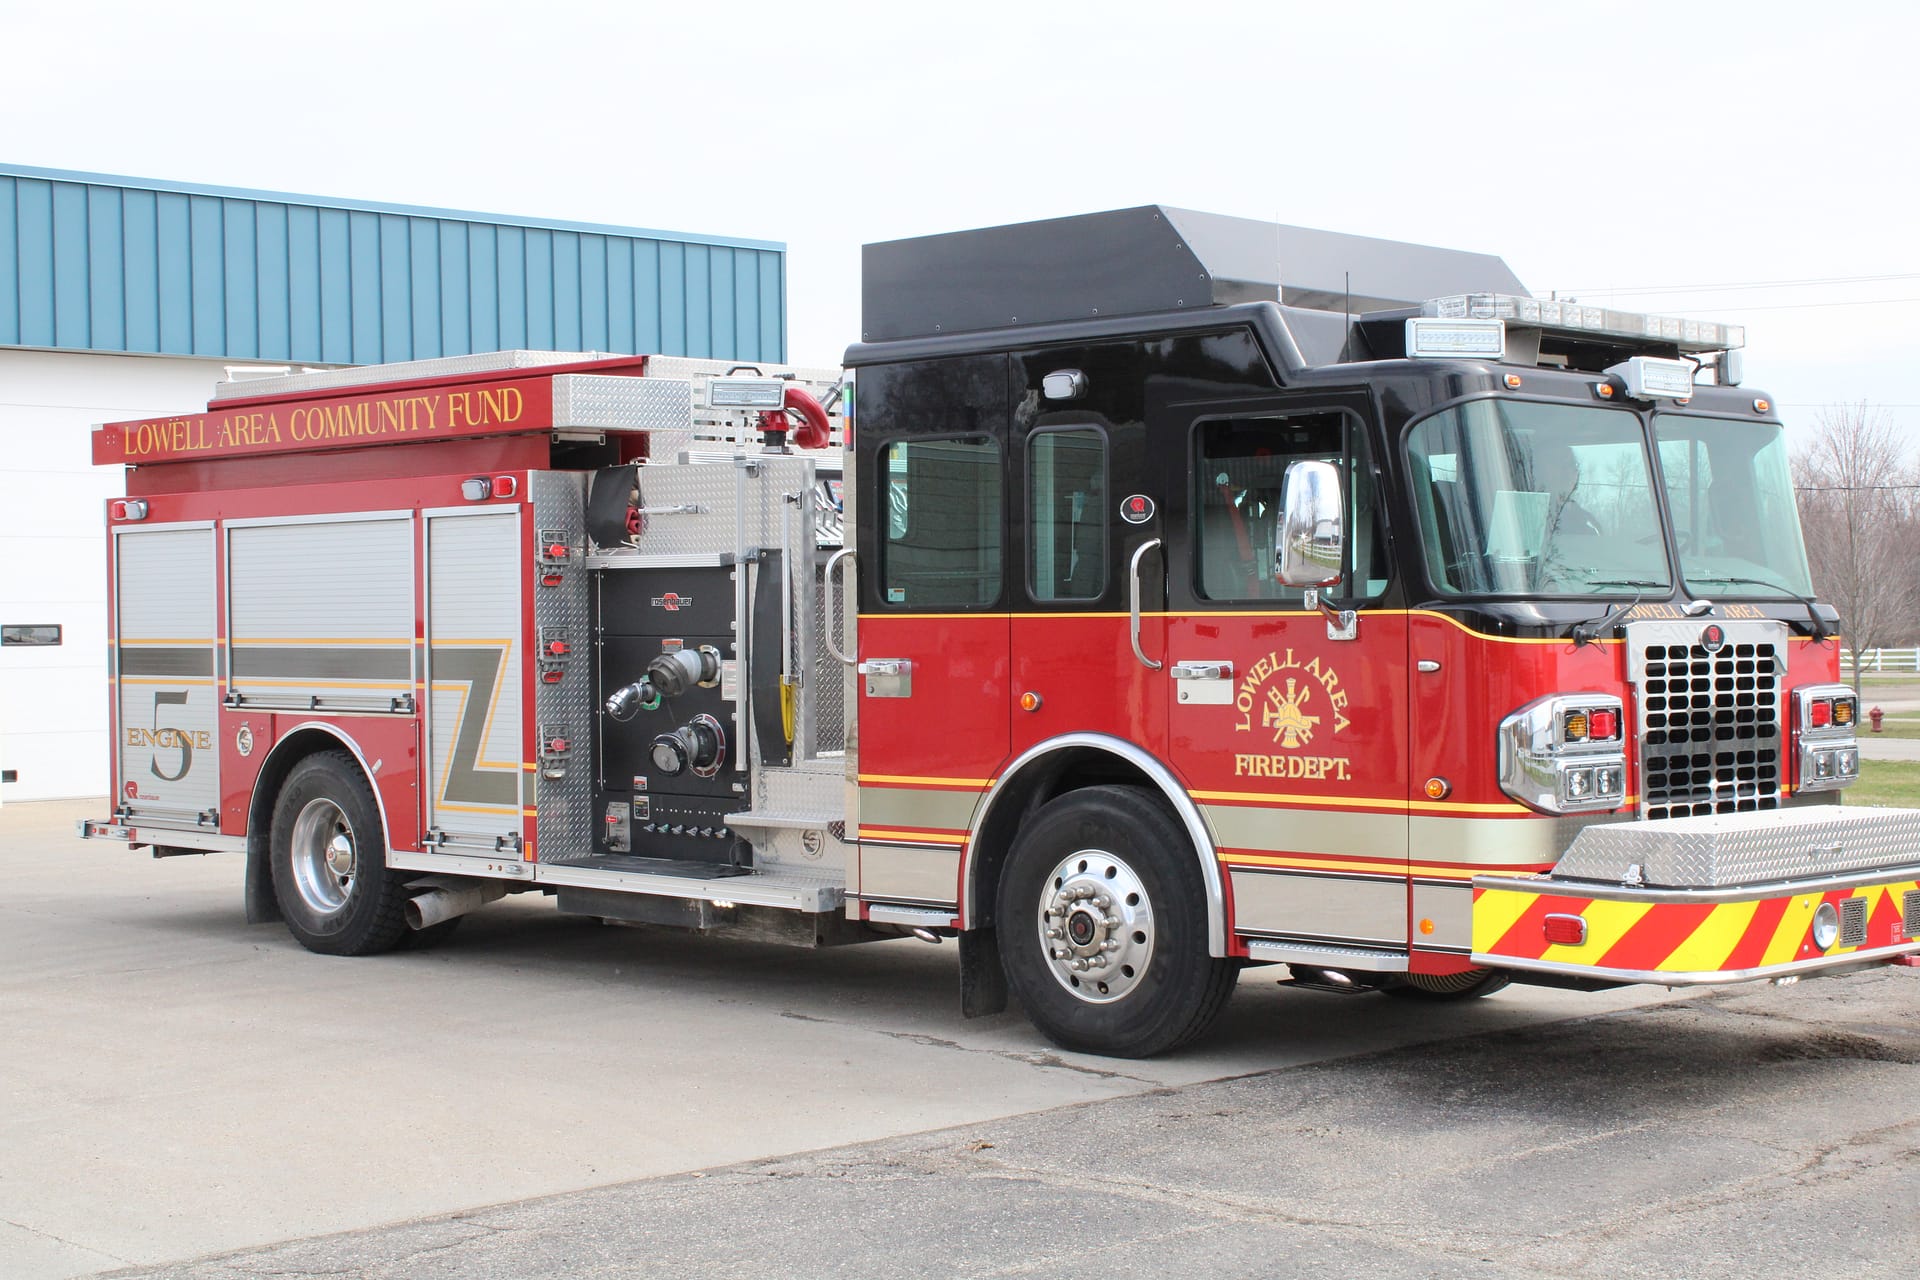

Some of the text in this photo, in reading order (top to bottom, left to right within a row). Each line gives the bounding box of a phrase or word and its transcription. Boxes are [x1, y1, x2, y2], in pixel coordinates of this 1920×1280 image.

[124, 387, 524, 455] LOWELL AREA COMMUNITY FUND
[1722, 604, 1766, 619] AREA
[1235, 648, 1350, 733] LOWELL AREA
[127, 727, 212, 750] ENGINE
[151, 689, 191, 781] 5
[1235, 754, 1286, 777] FIRE
